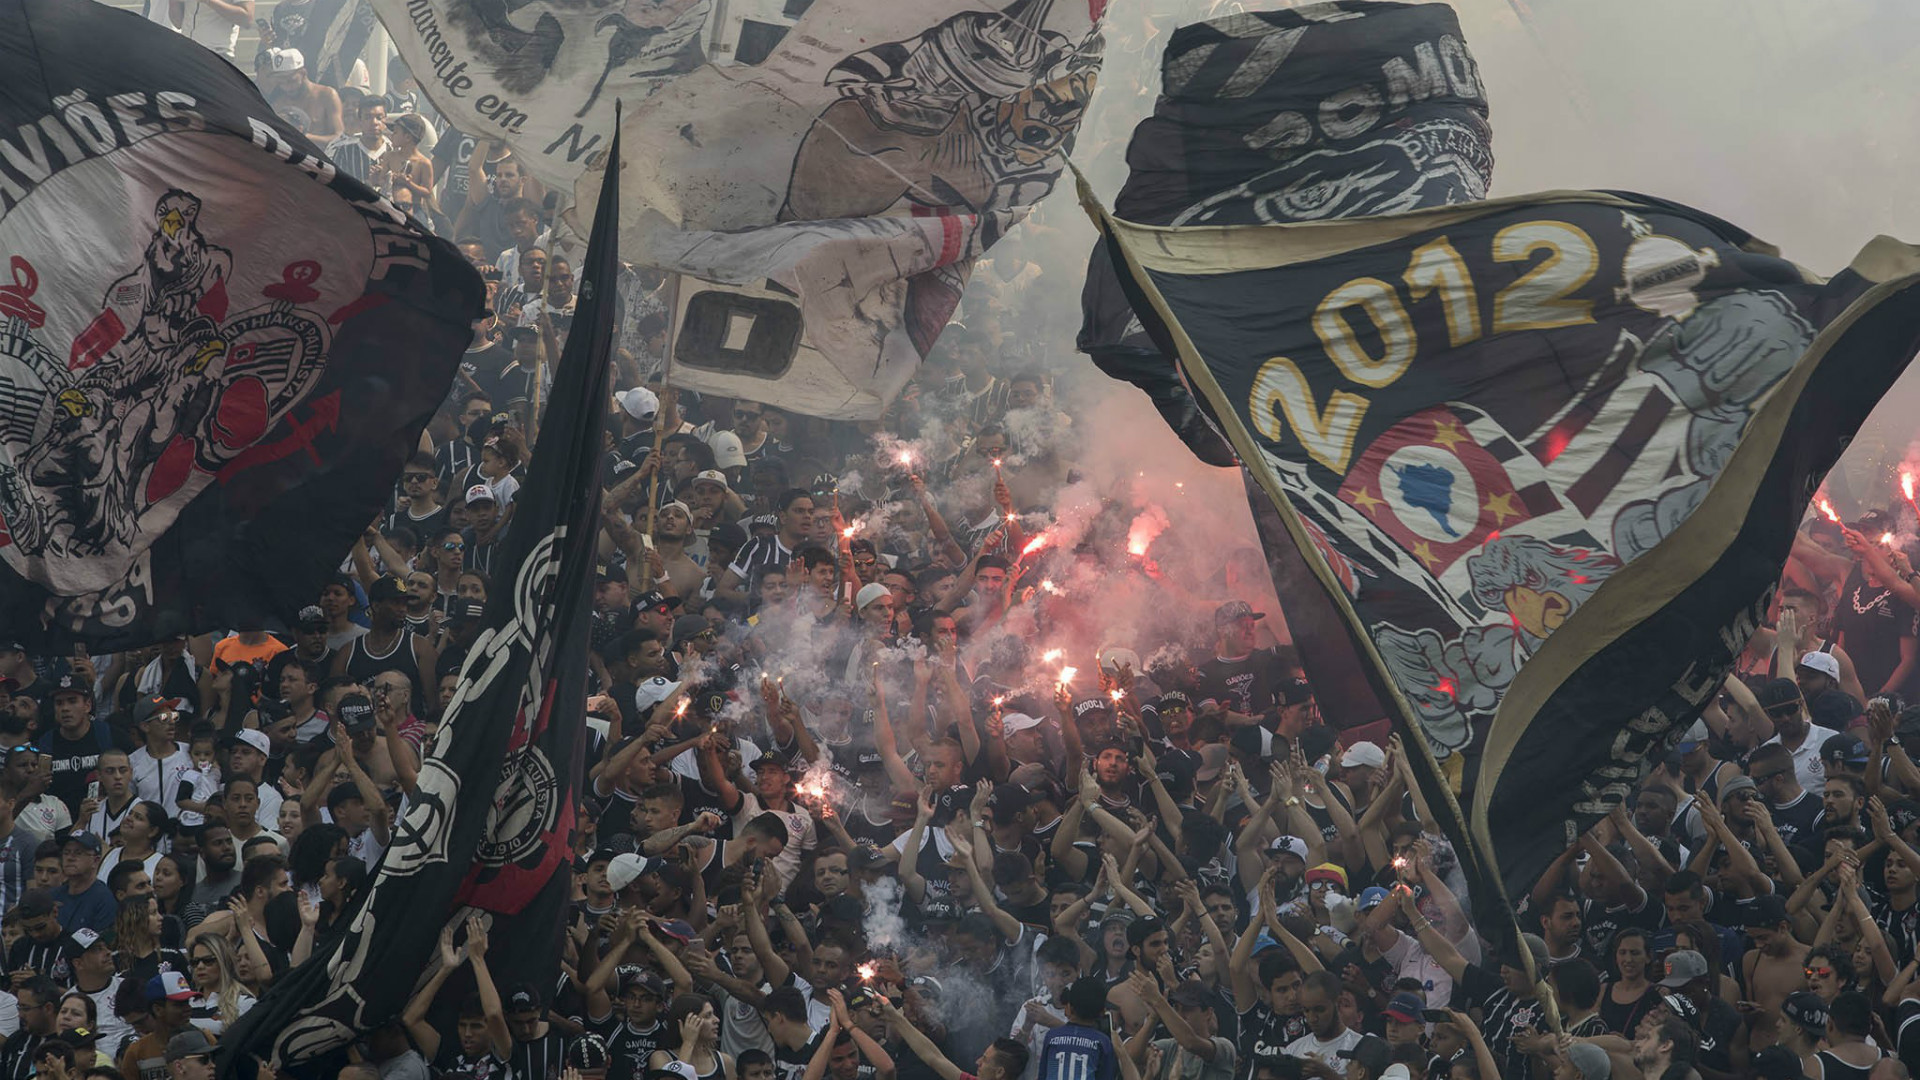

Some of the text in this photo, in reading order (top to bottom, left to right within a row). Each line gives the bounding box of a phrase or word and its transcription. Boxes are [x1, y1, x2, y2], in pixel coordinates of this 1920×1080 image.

[475, 93, 529, 130] em
[223, 314, 308, 341] NTHIANS
[1250, 220, 1600, 476] 2012
[1075, 699, 1105, 716] MOOCA
[1049, 1035, 1101, 1051] CORINTHIANS
[1055, 1051, 1089, 1080] 10
